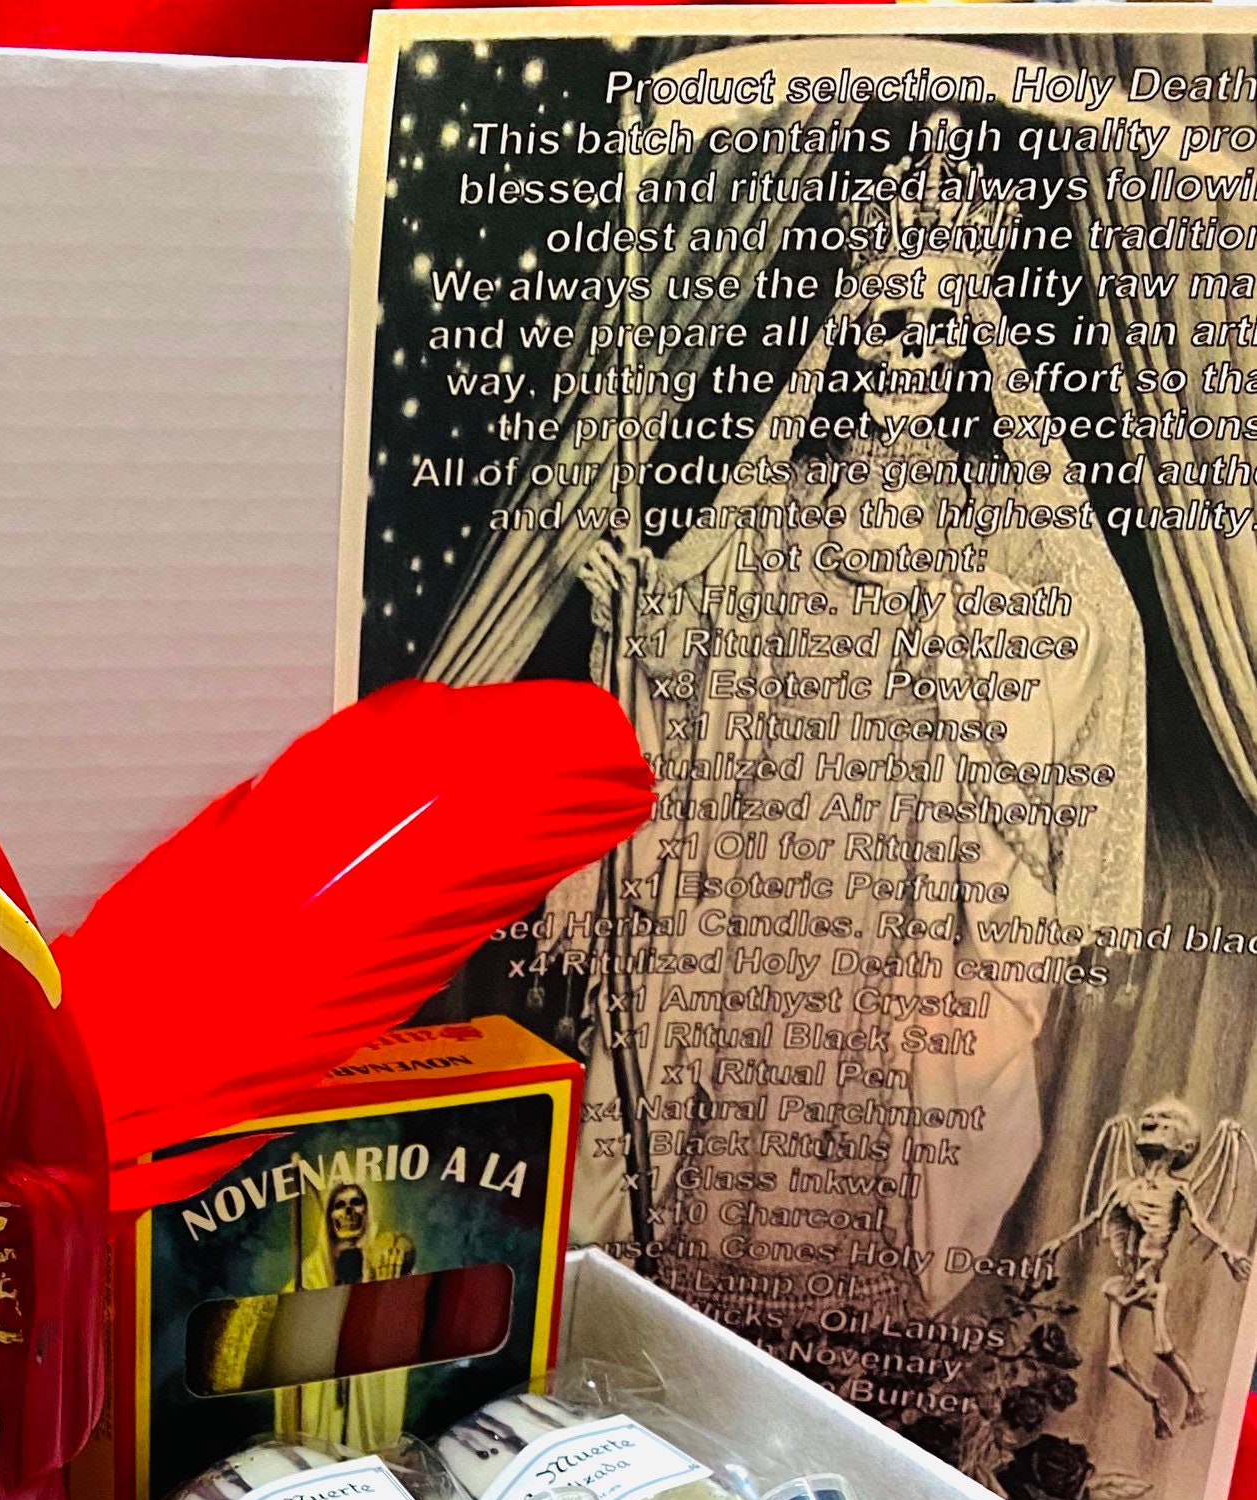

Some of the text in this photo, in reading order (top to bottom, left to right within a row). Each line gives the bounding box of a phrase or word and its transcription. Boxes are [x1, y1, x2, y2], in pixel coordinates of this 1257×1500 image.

[606, 68, 776, 104] Product
[786, 67, 996, 104] selection.
[1013, 67, 1114, 111] Holy
[473, 117, 1170, 160] This batch contains high quality
[460, 168, 1088, 209] blessed and ritualized always
[546, 217, 1072, 258] oldest and most genuine
[432, 266, 1178, 309] We always use the best quality raw
[429, 315, 1179, 356] and we prepare all the articles in an
[553, 362, 1189, 404] putting the maximum effort so
[498, 410, 981, 448] the products meet your
[412, 453, 1146, 493] All of our products are genuine and
[488, 498, 1094, 538] and we guarantee the highest
[736, 541, 988, 573] Lot Content:
[641, 584, 1073, 622] x1 Figure. Holy death
[623, 627, 1080, 660] x1 Ritualized Necklace
[649, 669, 1041, 702] x8 Esoteric Powder
[666, 711, 1008, 743] x1 Ritual Incense
[815, 751, 1116, 787] Herbal Incense
[819, 792, 1098, 828] Air Freshener
[658, 830, 982, 863] x1 Oil for Rituals
[620, 870, 1011, 904] x1 Esoteric Perfume
[565, 908, 1173, 951] Herbal Candles. white and
[561, 946, 1111, 987] Ritulized Holy Death candles
[660, 983, 991, 1021] Amethyst Crystal
[663, 1020, 978, 1056] Ritual Black Salt
[716, 1058, 912, 1090] Ritual Pen
[635, 1093, 986, 1131] Natural Parchment
[649, 1129, 964, 1166] Black Rituals Ink
[181, 1143, 528, 1241] NOVENARIO A LA
[674, 1165, 922, 1200] Glass inkwell
[719, 1199, 886, 1233] Charcoal
[720, 1235, 1055, 1283] Cones Holy Death
[694, 1269, 794, 1300] Lamp
[806, 1273, 857, 1298] Oil
[820, 1308, 1006, 1349] Oil Lamps
[787, 1339, 963, 1384] Novenary
[849, 1380, 980, 1414] Burner
[535, 1439, 636, 1485] Muerte
